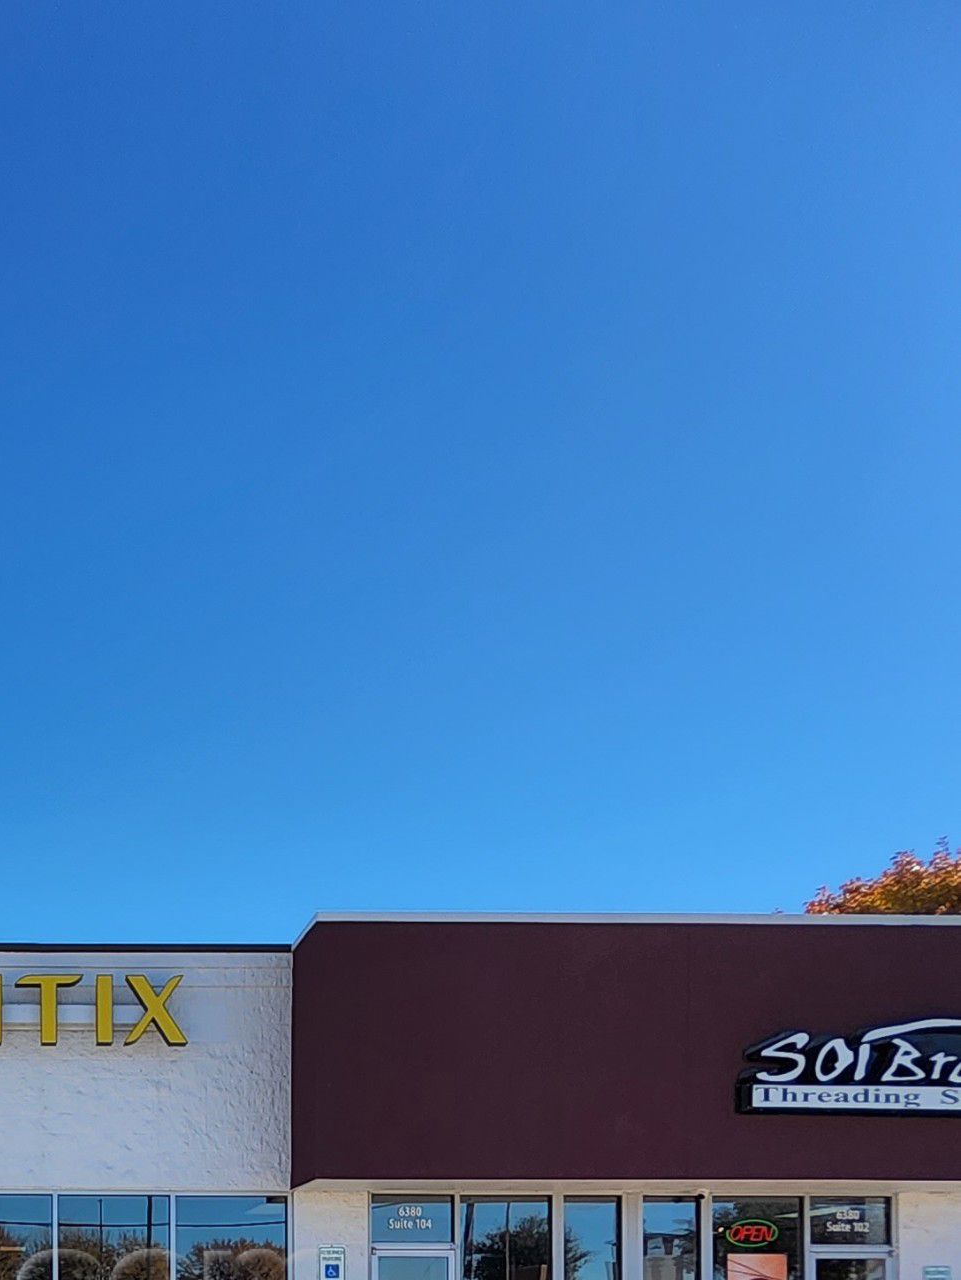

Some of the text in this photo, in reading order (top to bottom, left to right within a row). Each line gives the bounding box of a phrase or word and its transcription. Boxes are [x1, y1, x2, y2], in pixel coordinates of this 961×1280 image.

[755, 1087, 920, 1107] Threading
[398, 1206, 422, 1217] 6380
[389, 1218, 432, 1229] Suite 104
[826, 1221, 851, 1232] Suite
[730, 1225, 774, 1241] OPEN
